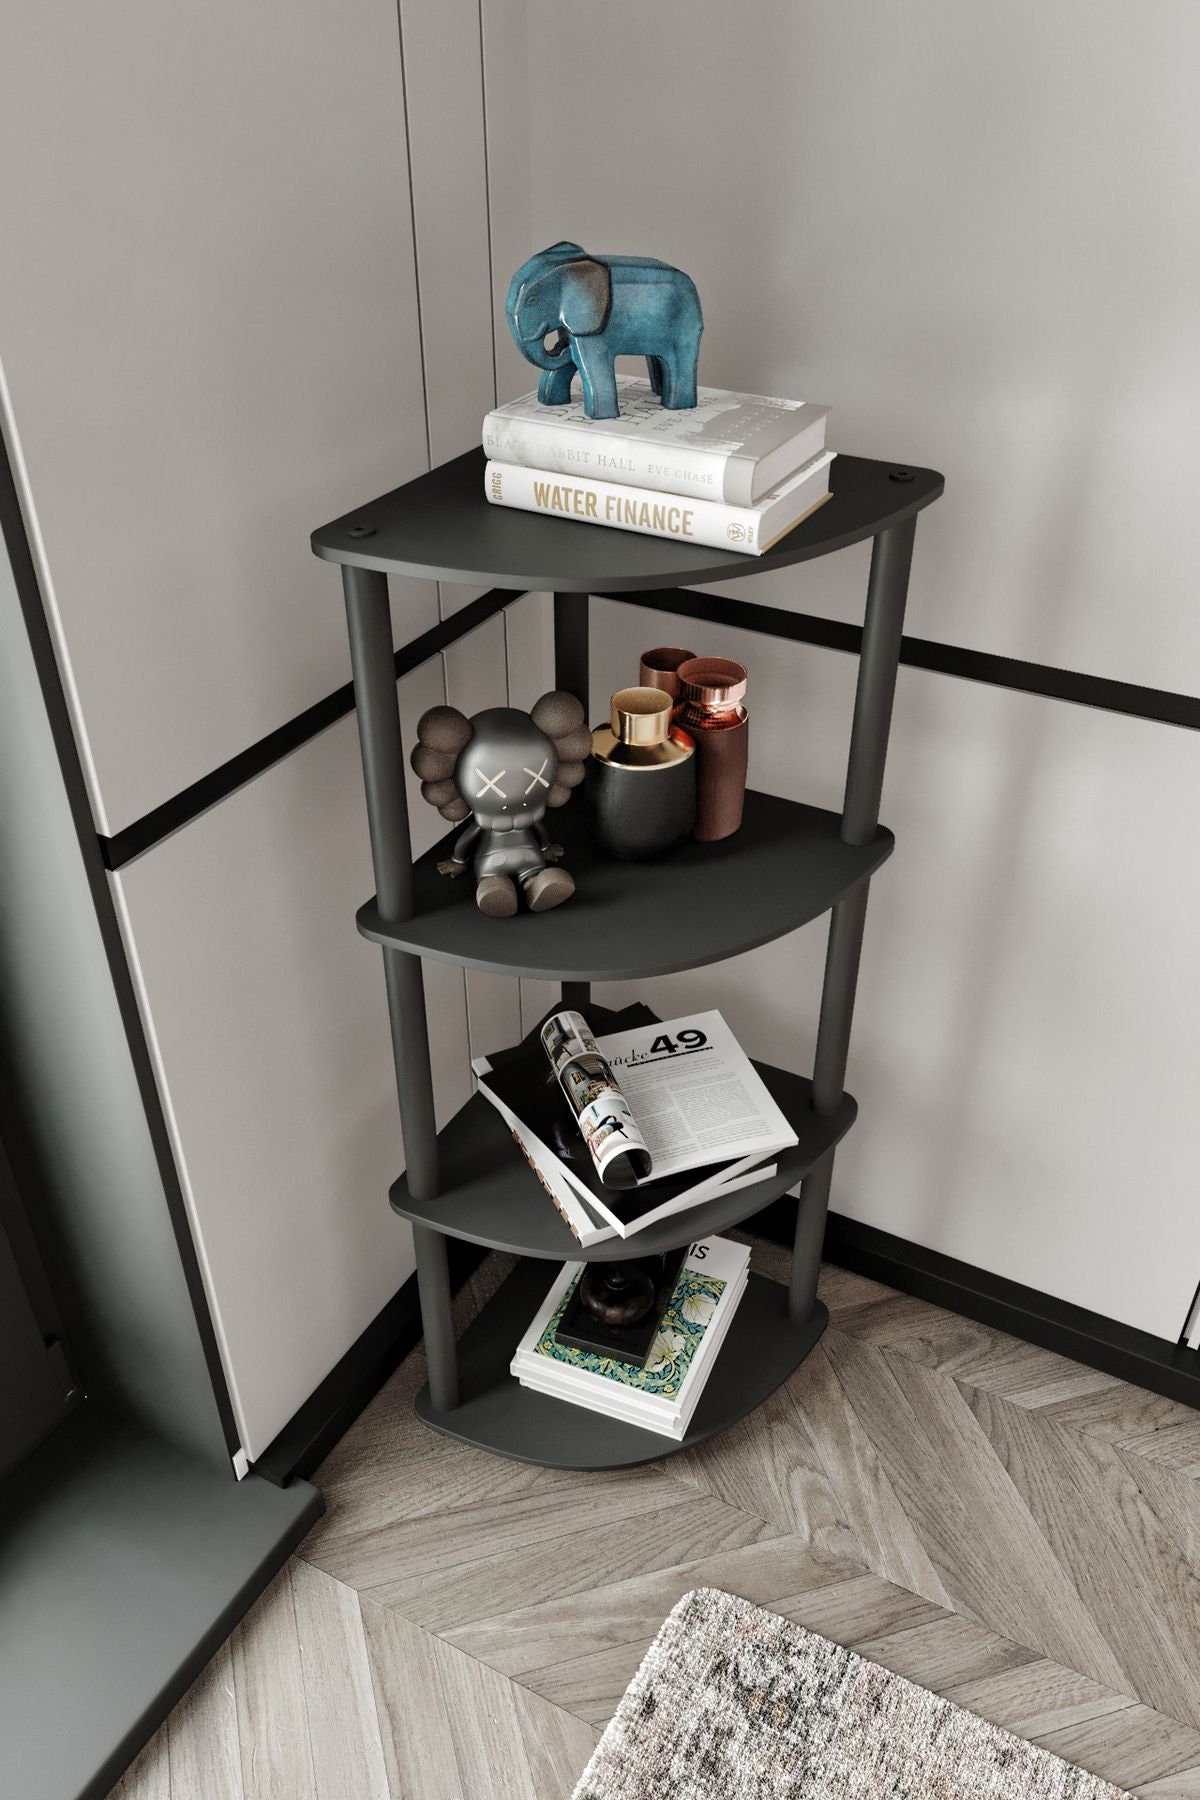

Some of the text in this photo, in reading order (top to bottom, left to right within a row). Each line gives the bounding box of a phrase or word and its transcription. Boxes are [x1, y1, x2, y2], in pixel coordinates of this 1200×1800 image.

[597, 454, 636, 472] HALL
[648, 464, 714, 485] EVE CHASE
[491, 472, 503, 500] GRIGG
[533, 481, 694, 536] WATER FINANCE
[650, 1029, 708, 1054] 49
